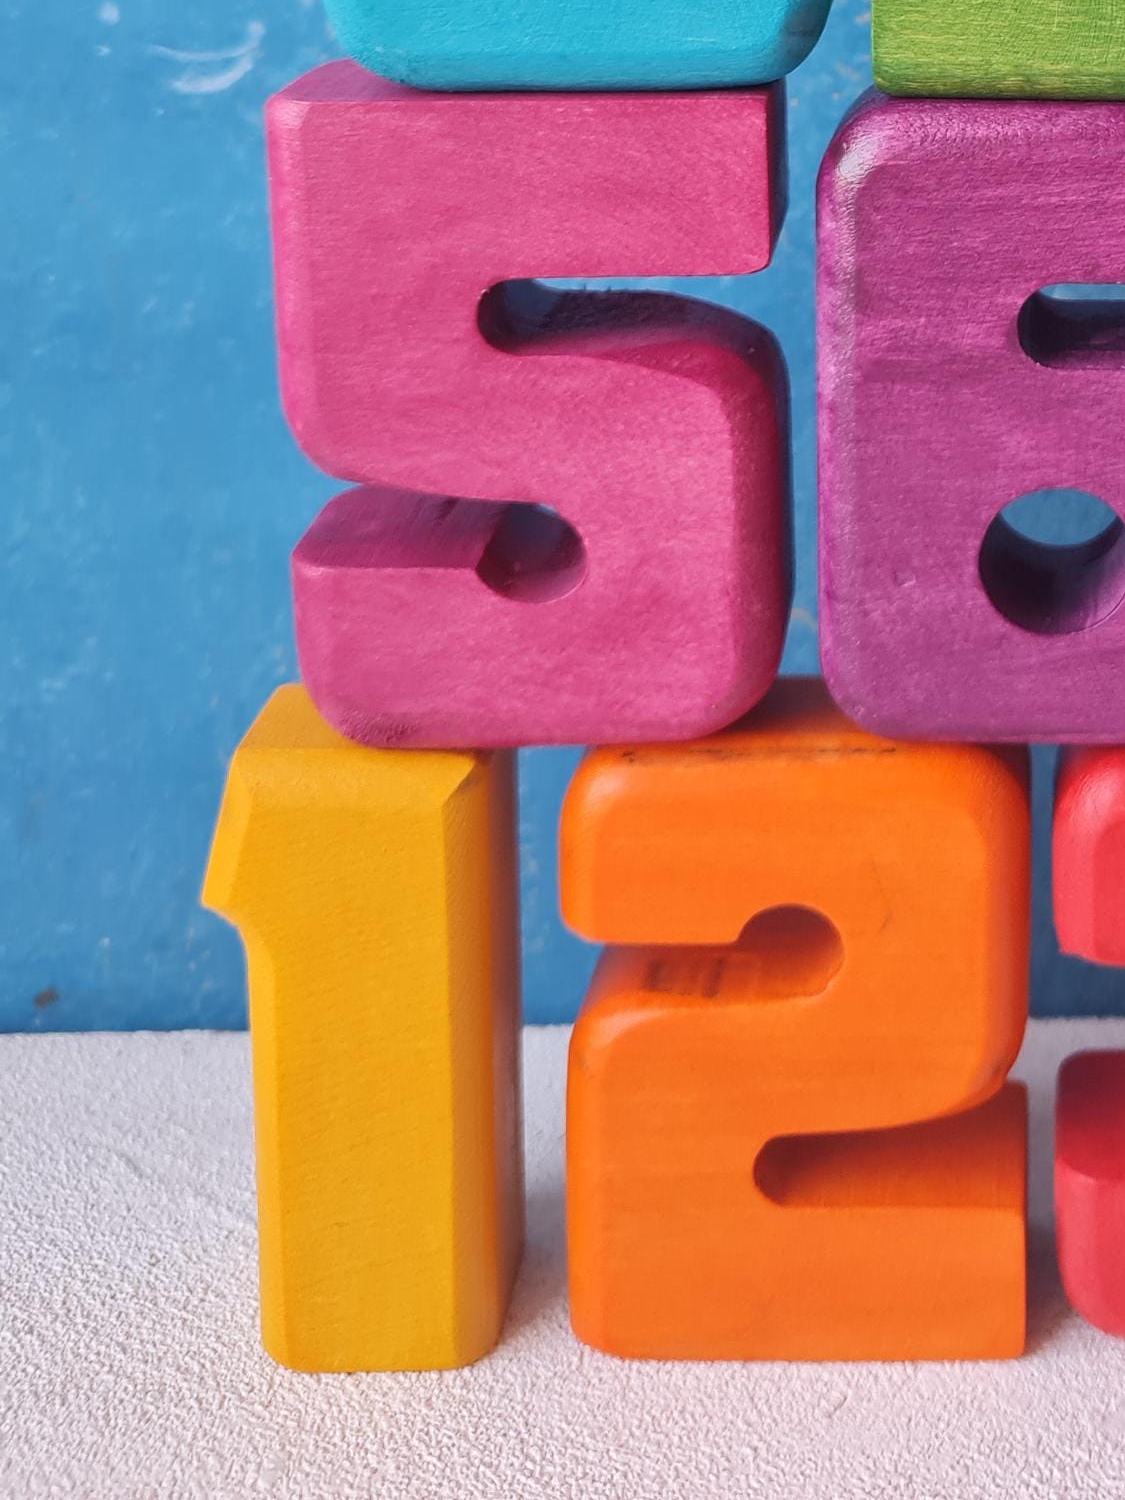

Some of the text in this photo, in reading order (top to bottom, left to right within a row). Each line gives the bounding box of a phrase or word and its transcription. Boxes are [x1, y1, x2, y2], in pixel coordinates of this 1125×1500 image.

[265, 59, 794, 748] 5
[201, 683, 525, 1372] 1
[558, 676, 1030, 1361] 2
